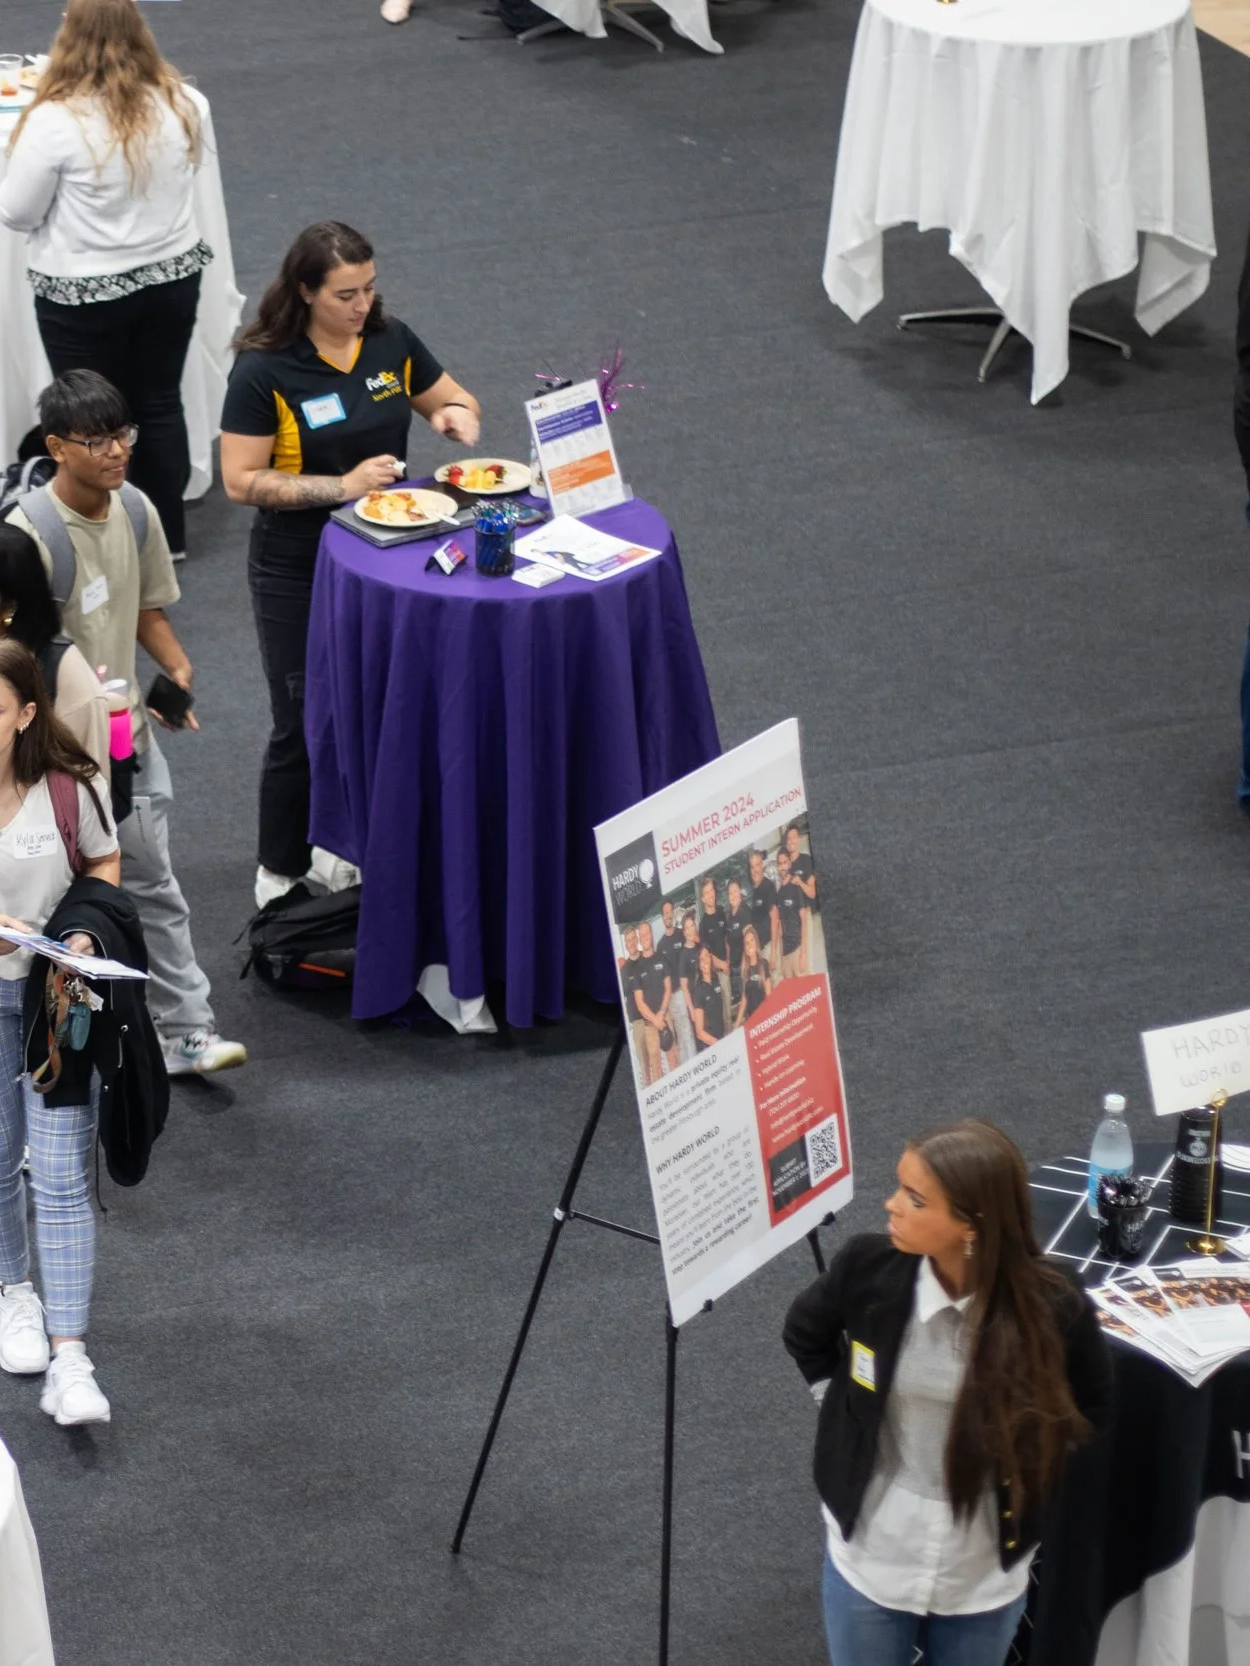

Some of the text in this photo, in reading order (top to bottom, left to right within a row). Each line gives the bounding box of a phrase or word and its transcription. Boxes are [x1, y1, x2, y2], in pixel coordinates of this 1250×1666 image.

[661, 792, 755, 858] SUMMER 2024
[664, 789, 802, 875] STUDENT INTERN APPLICATION
[612, 864, 639, 891] HARDY
[749, 987, 821, 1038] INTERNSHIP PROGRAM
[645, 1054, 717, 1106] ABOUT HARDY WORLD
[655, 1126, 719, 1174] WHY HARDY WORLD
